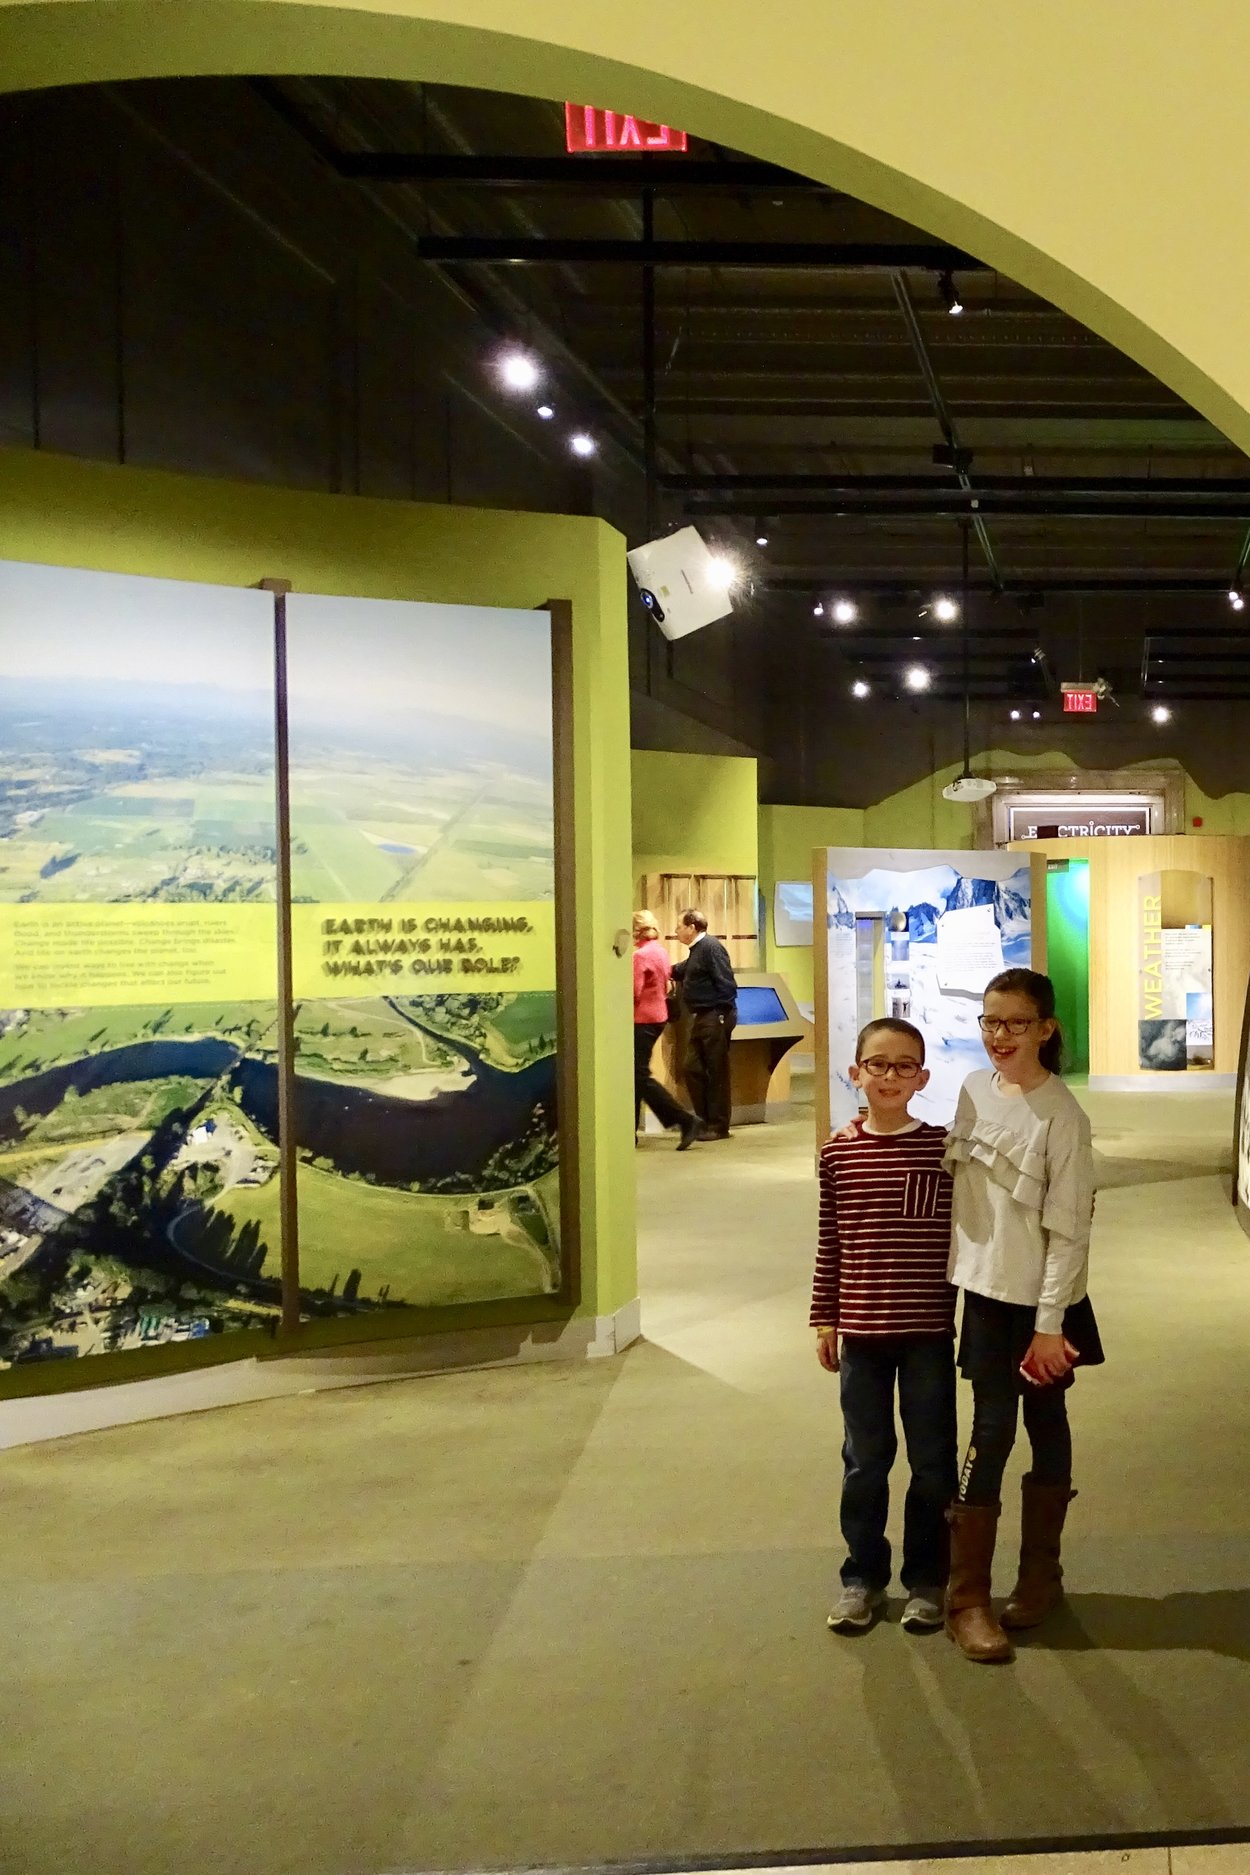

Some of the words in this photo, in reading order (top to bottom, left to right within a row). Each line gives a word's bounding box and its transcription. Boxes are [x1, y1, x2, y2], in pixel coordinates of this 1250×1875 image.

[1022, 821, 1140, 839] ECTRICITY
[322, 918, 393, 935] EARTH
[399, 918, 418, 934] IS
[323, 939, 344, 955] IT
[349, 938, 431, 955] ALWAYS
[409, 958, 453, 975] OUR
[459, 956, 521, 973] ROLE?
[1143, 895, 1163, 1020] WEATHER
